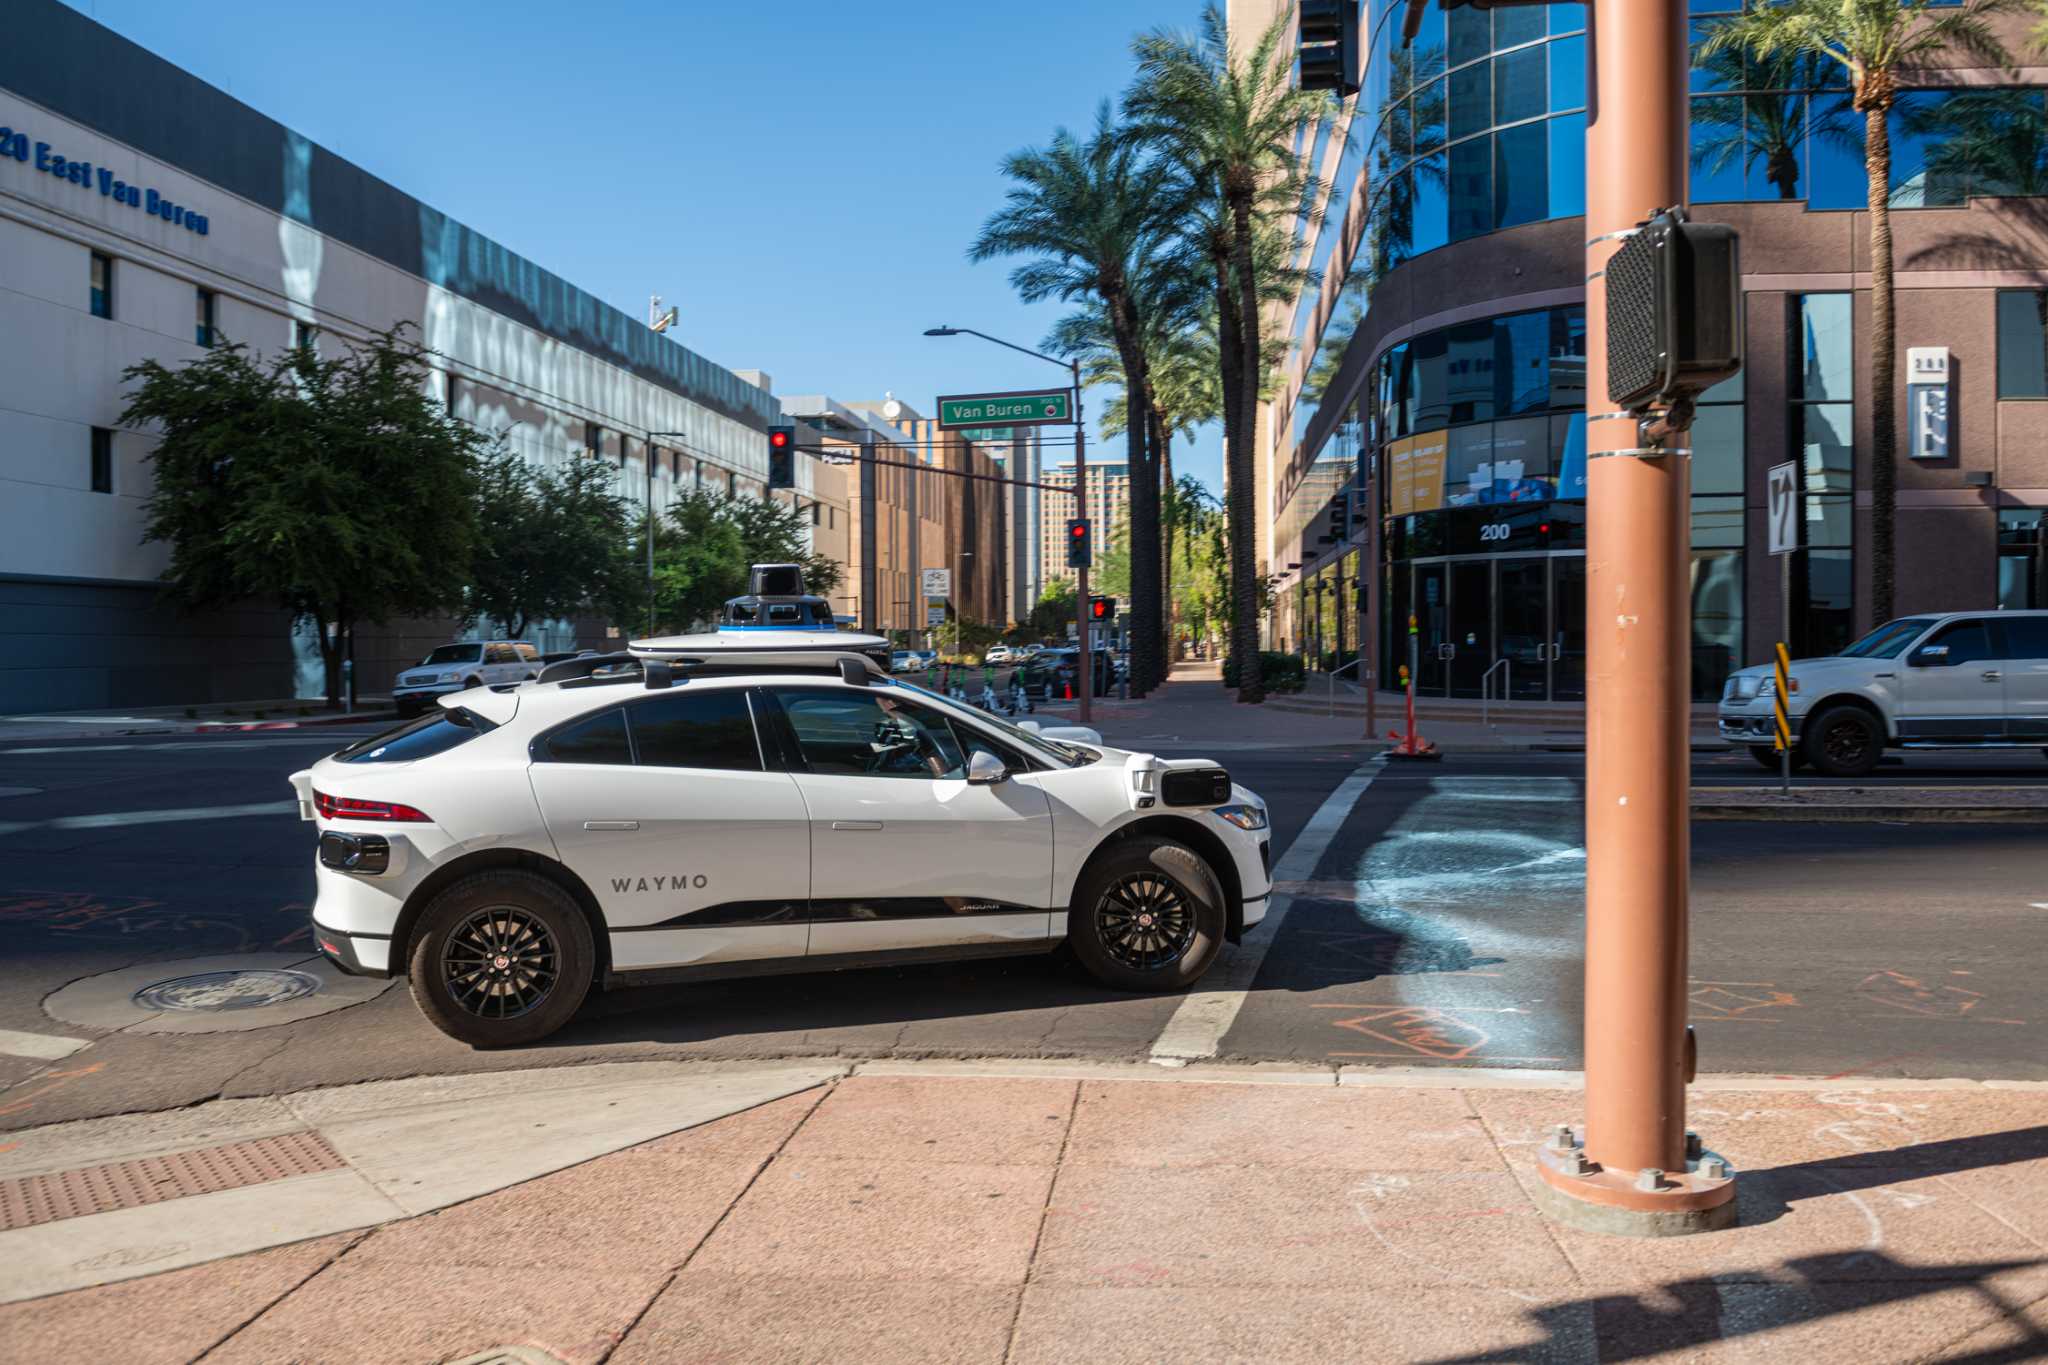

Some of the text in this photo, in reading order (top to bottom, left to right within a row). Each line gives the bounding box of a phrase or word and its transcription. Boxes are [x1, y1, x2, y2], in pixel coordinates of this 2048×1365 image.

[35, 142, 92, 188] East
[97, 167, 140, 208] Van
[146, 188, 209, 236] Buren
[952, 402, 1032, 419] Van Buren
[1480, 523, 1511, 540] 200
[611, 874, 708, 893] WAYMO
